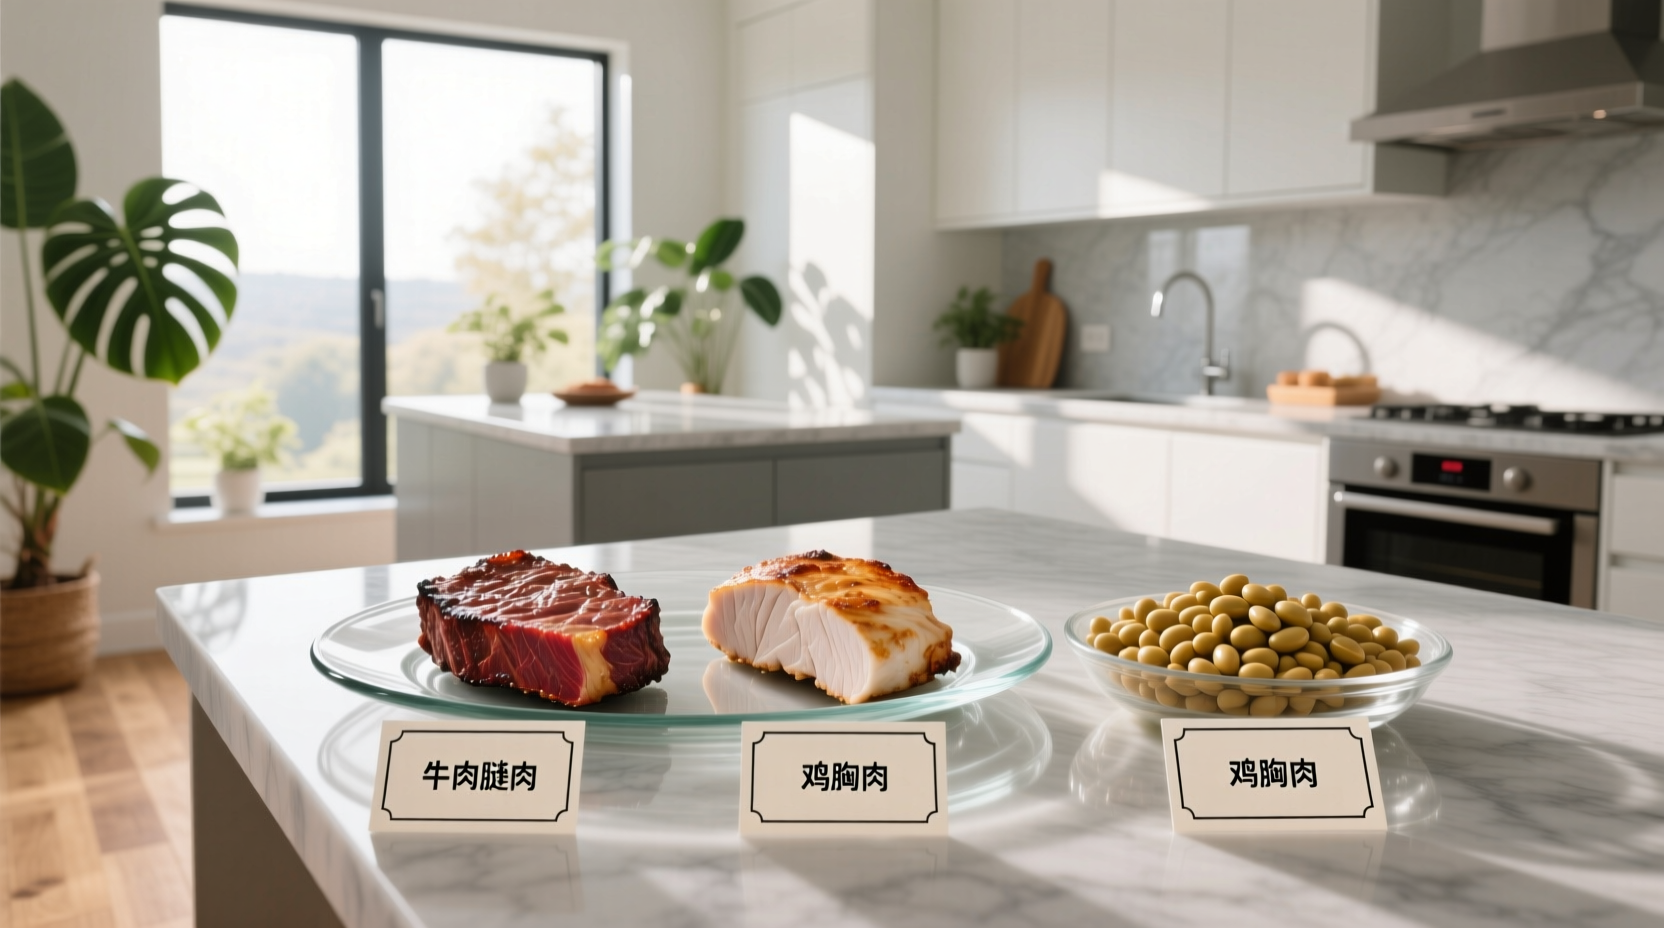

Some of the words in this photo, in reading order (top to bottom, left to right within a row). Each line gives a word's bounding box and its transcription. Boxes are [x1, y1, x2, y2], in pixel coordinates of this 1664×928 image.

[801, 761, 888, 792] 鸡胸肉
[1229, 758, 1318, 788] 鸡胸肉
